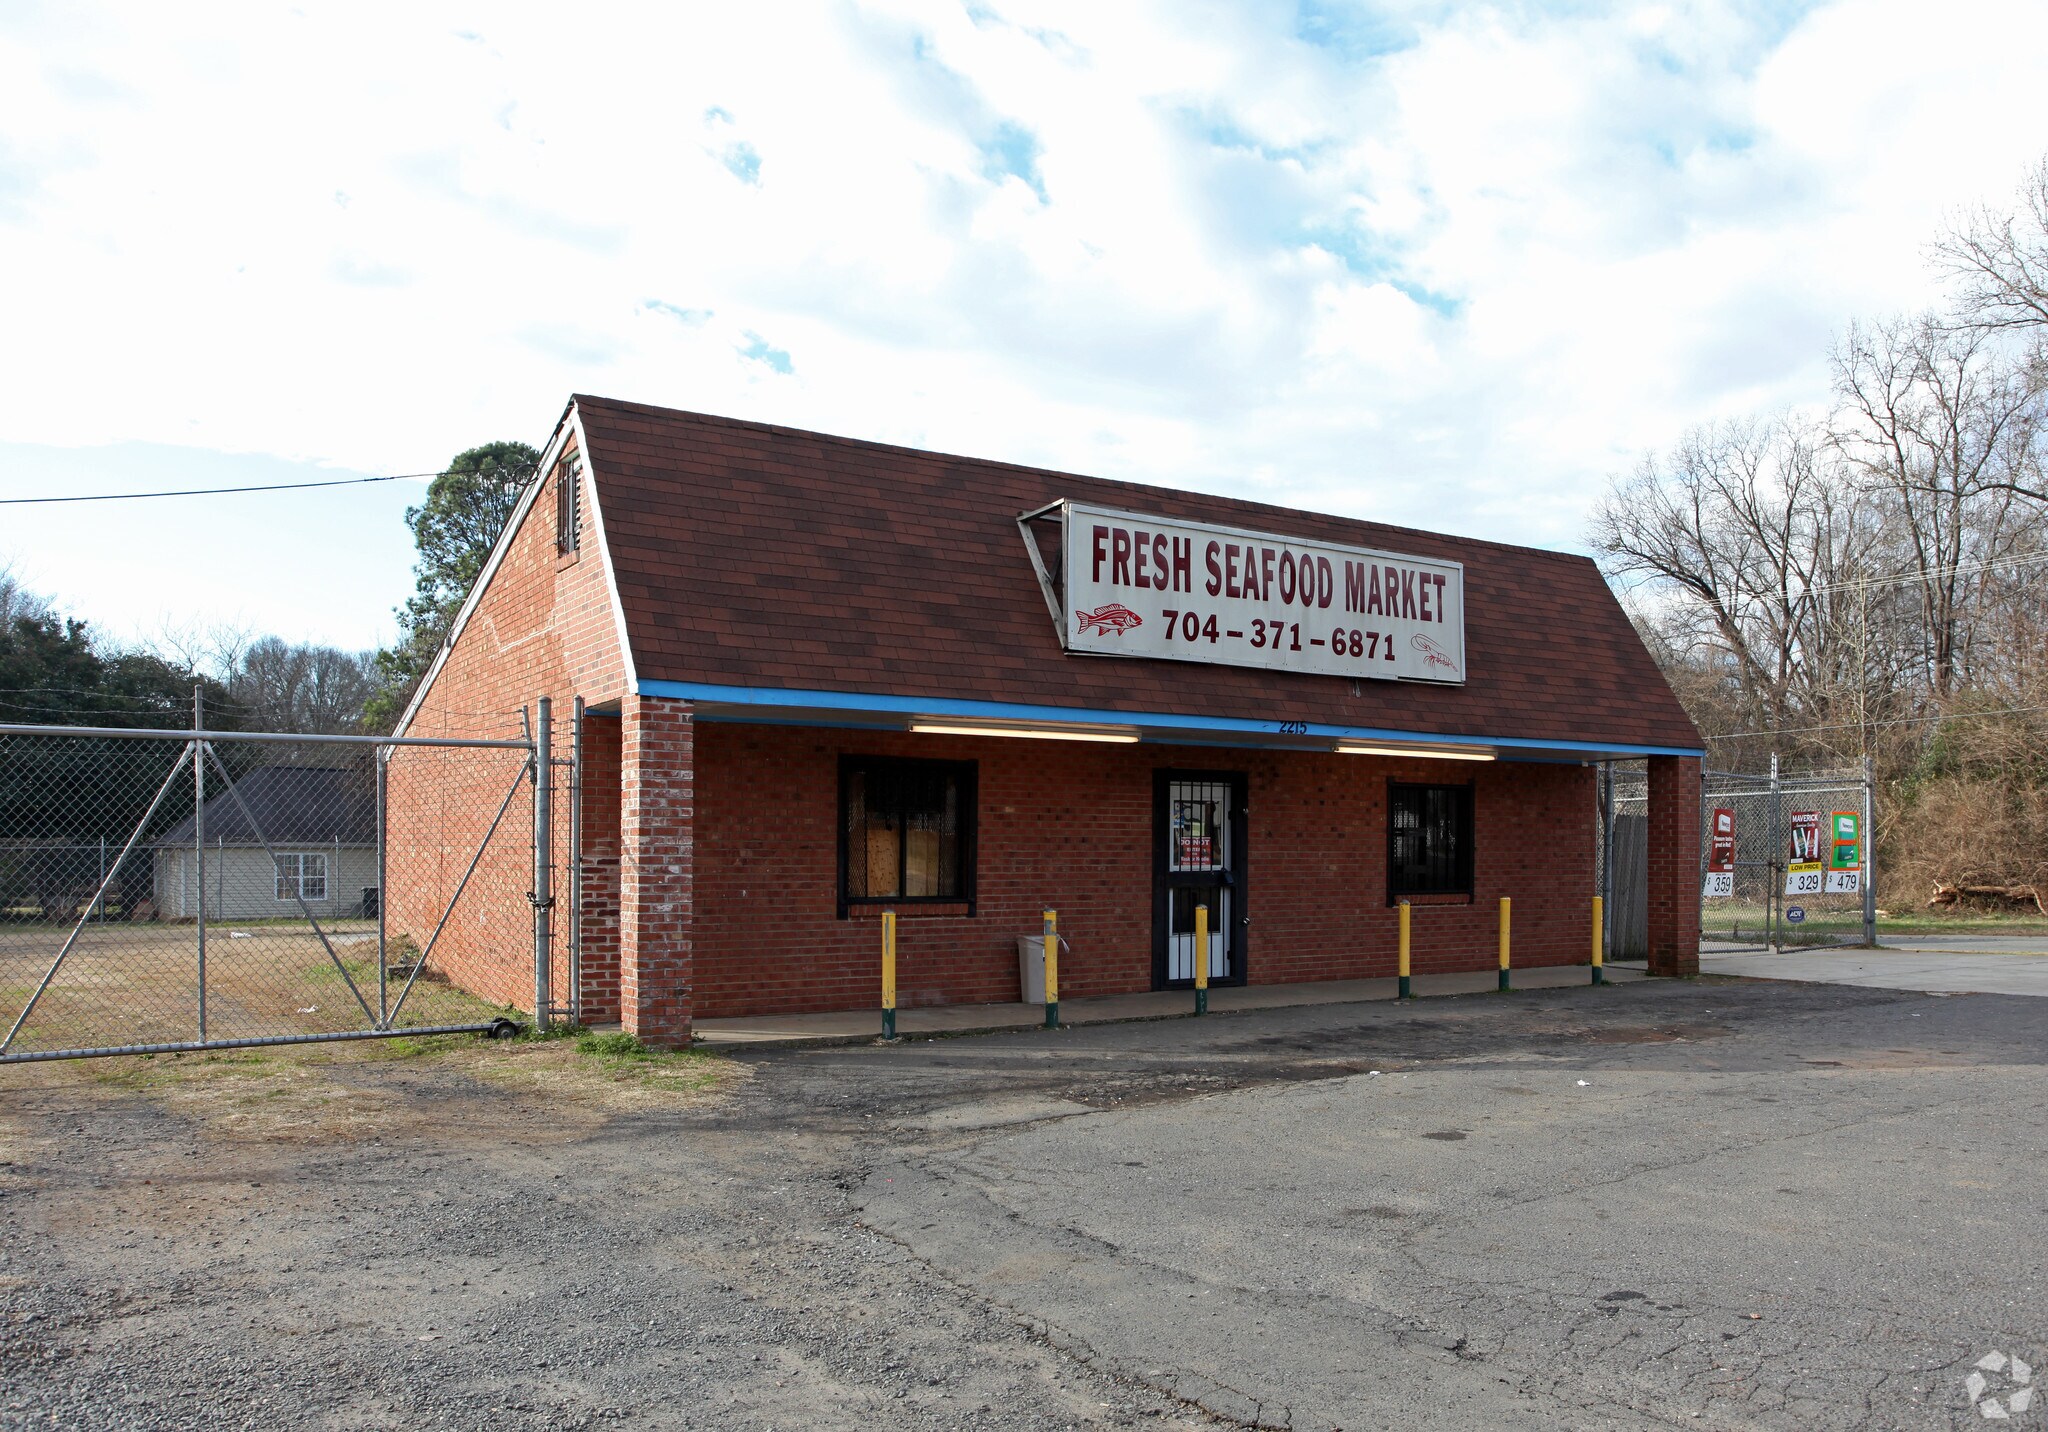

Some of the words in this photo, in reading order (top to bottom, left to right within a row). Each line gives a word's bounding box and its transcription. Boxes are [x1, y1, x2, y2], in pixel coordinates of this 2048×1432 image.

[1092, 525, 1191, 593] FRESH
[1205, 540, 1334, 609] SEAFOOD
[1345, 560, 1446, 624] MARKET
[1279, 720, 1307, 735] 2215
[1792, 814, 1819, 823] MAVERICK
